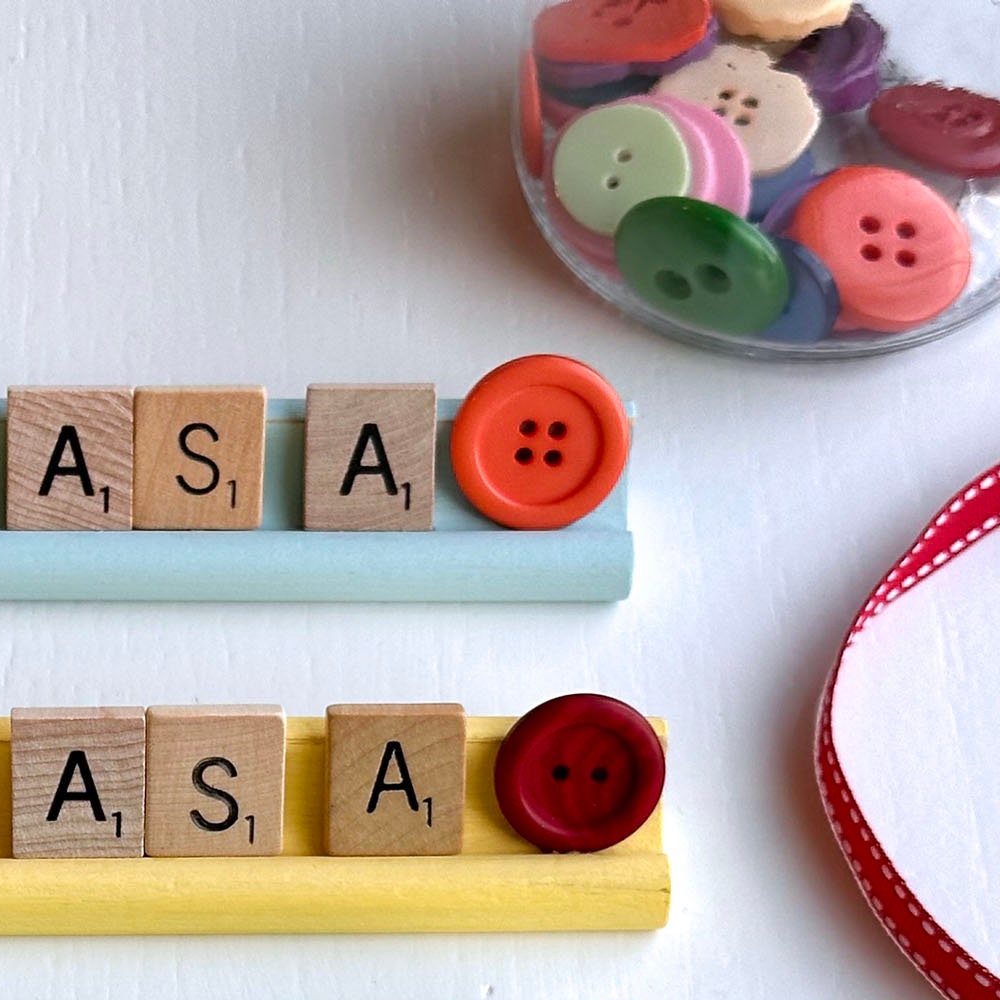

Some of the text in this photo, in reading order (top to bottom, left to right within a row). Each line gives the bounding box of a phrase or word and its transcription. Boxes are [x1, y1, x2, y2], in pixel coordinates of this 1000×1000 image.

[338, 421, 400, 497] A
[98, 484, 111, 515] 1
[225, 478, 238, 510] 1
[400, 480, 412, 512] 1
[365, 739, 421, 815] A
[110, 810, 123, 839] 1
[243, 814, 256, 846] 1
[421, 795, 434, 829] 1
